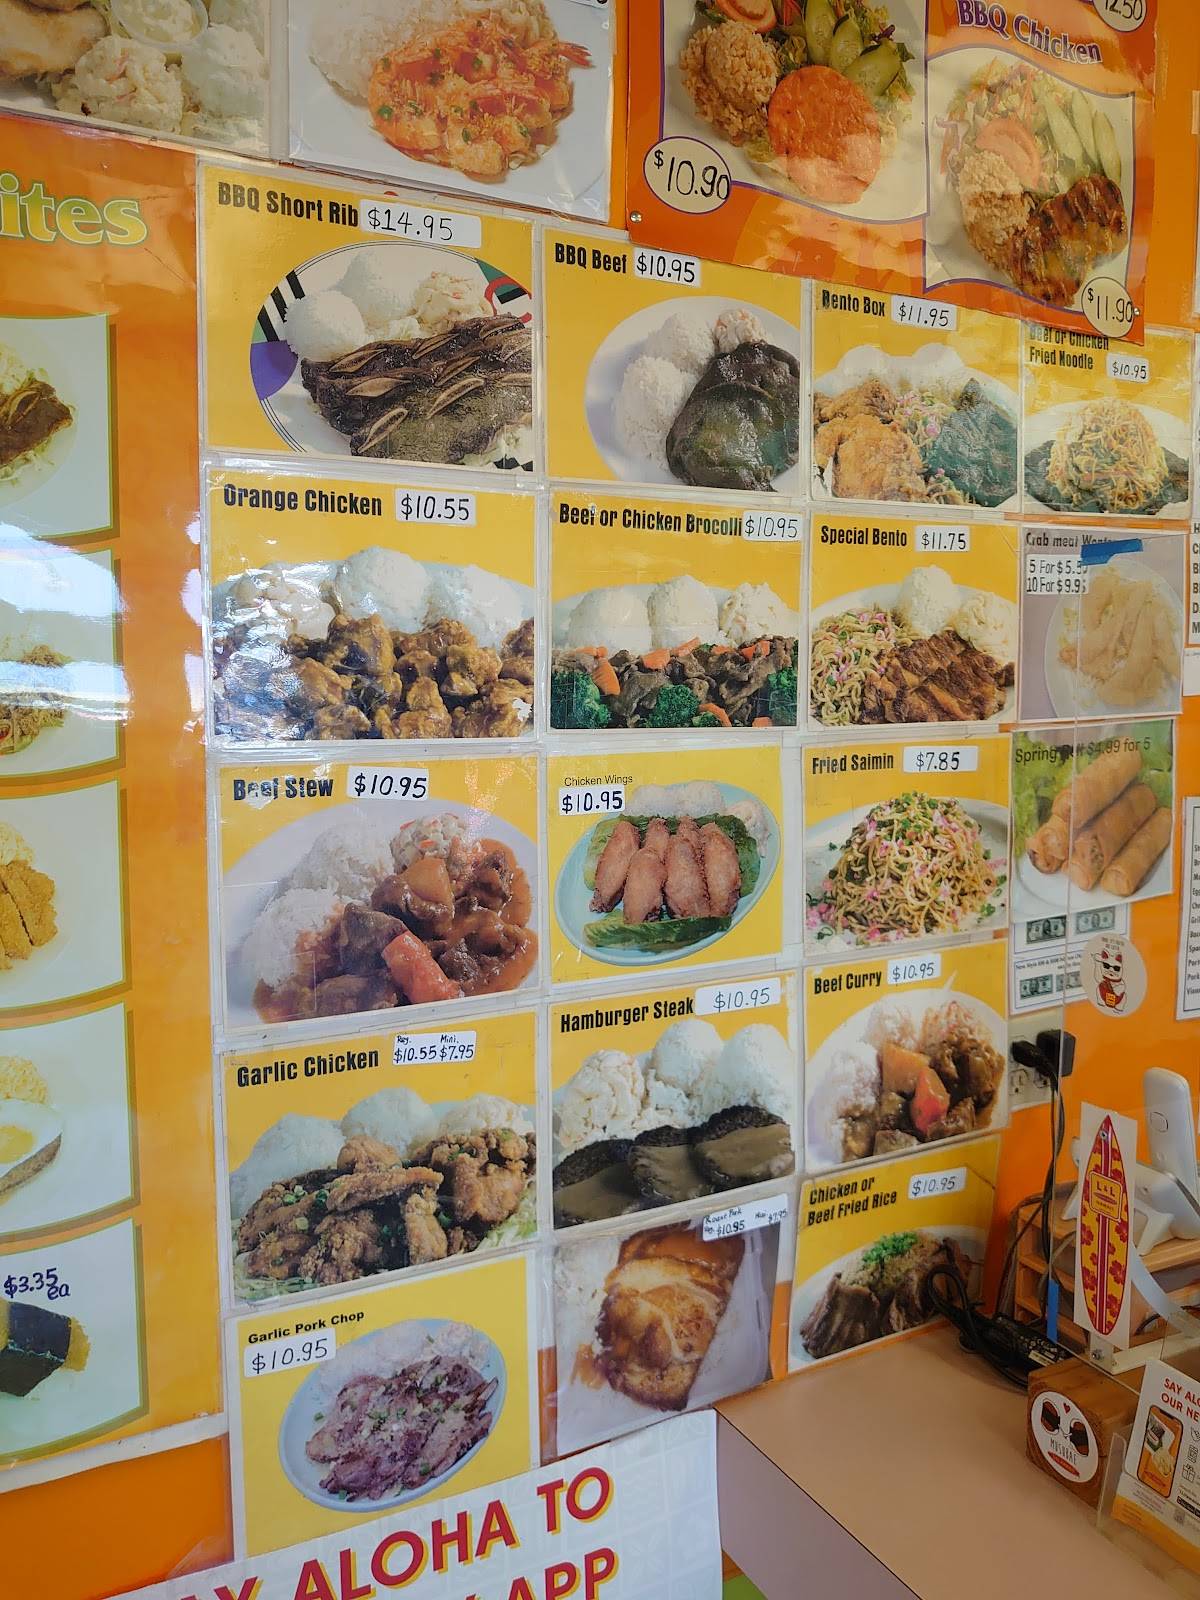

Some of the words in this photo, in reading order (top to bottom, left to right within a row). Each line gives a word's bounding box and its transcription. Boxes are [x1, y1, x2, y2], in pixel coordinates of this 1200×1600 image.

[957, 0, 1009, 39] BBQ
[1013, 14, 1102, 64] Chicken
[653, 149, 730, 200] $10.90
[0, 173, 147, 245] ites
[218, 182, 260, 212] BBQ
[266, 190, 323, 222] Short
[329, 201, 358, 228] Rib
[368, 207, 453, 241] $14.95
[555, 243, 587, 269] BBQ
[592, 249, 627, 274] Beef
[636, 252, 695, 283] $10.95
[822, 289, 859, 312] Bento
[863, 297, 885, 317] Box
[898, 302, 949, 327] $11.95
[1087, 287, 1133, 322] $11.90
[1030, 325, 1052, 342] Beef
[1055, 330, 1066, 344] or
[1069, 332, 1109, 350] Chicken
[1030, 346, 1056, 365] Fried
[1059, 350, 1094, 370] Noodle
[1112, 361, 1147, 379] $10.95
[224, 483, 298, 511] Orange
[305, 489, 382, 516] Chicken
[401, 493, 469, 520] $10.55
[559, 503, 596, 527] Beef
[600, 509, 617, 527] or
[622, 508, 681, 532] Chicken
[686, 513, 743, 537] Brocolli
[744, 516, 798, 538] $10.95
[821, 525, 868, 545] Special
[872, 528, 907, 547] Bento
[921, 531, 966, 550] $11.75
[1026, 532, 1049, 547] Crab
[1029, 559, 1036, 573] 5
[1040, 560, 1054, 574] For
[1026, 577, 1038, 592] 10
[1040, 577, 1055, 592] For
[812, 755, 847, 774] Fried
[851, 752, 894, 771] Saimin
[916, 751, 960, 771] $7.85
[1015, 746, 1057, 766] Spring
[1124, 737, 1140, 752] for
[1144, 736, 1151, 750] 5
[233, 777, 279, 800] Beef
[285, 776, 334, 798] Stew
[354, 772, 427, 798] $10.95
[564, 776, 602, 787] Chicken
[605, 774, 633, 785] Wings
[561, 790, 623, 814] $10.95
[814, 973, 842, 994] Beef
[846, 971, 882, 989] Curry
[892, 961, 935, 983] $10.95
[713, 987, 770, 1013] $10.95
[561, 1005, 649, 1033] Hamburger
[653, 997, 694, 1019] Steak
[393, 1045, 437, 1064] $10.55
[439, 1044, 474, 1061] $7.95
[237, 1062, 298, 1088] Garlic
[304, 1049, 379, 1077] Chicken
[809, 1179, 857, 1205] Chicken
[861, 1176, 875, 1191] or
[911, 1176, 957, 1197] $10.95
[807, 1205, 835, 1226] Beef
[837, 1196, 869, 1218] Fried
[872, 1190, 897, 1208] Rice
[4, 1268, 59, 1298] $3.35
[47, 1283, 71, 1300] ea
[248, 1328, 290, 1344] Garlic
[295, 1319, 326, 1334] Pork
[331, 1311, 365, 1326] Chop
[252, 1338, 328, 1375] $10.95
[1164, 1378, 1182, 1394] SAY
[1161, 1392, 1183, 1411] OUR
[290, 1500, 518, 1600] ALOHA
[537, 1467, 613, 1533] TO
